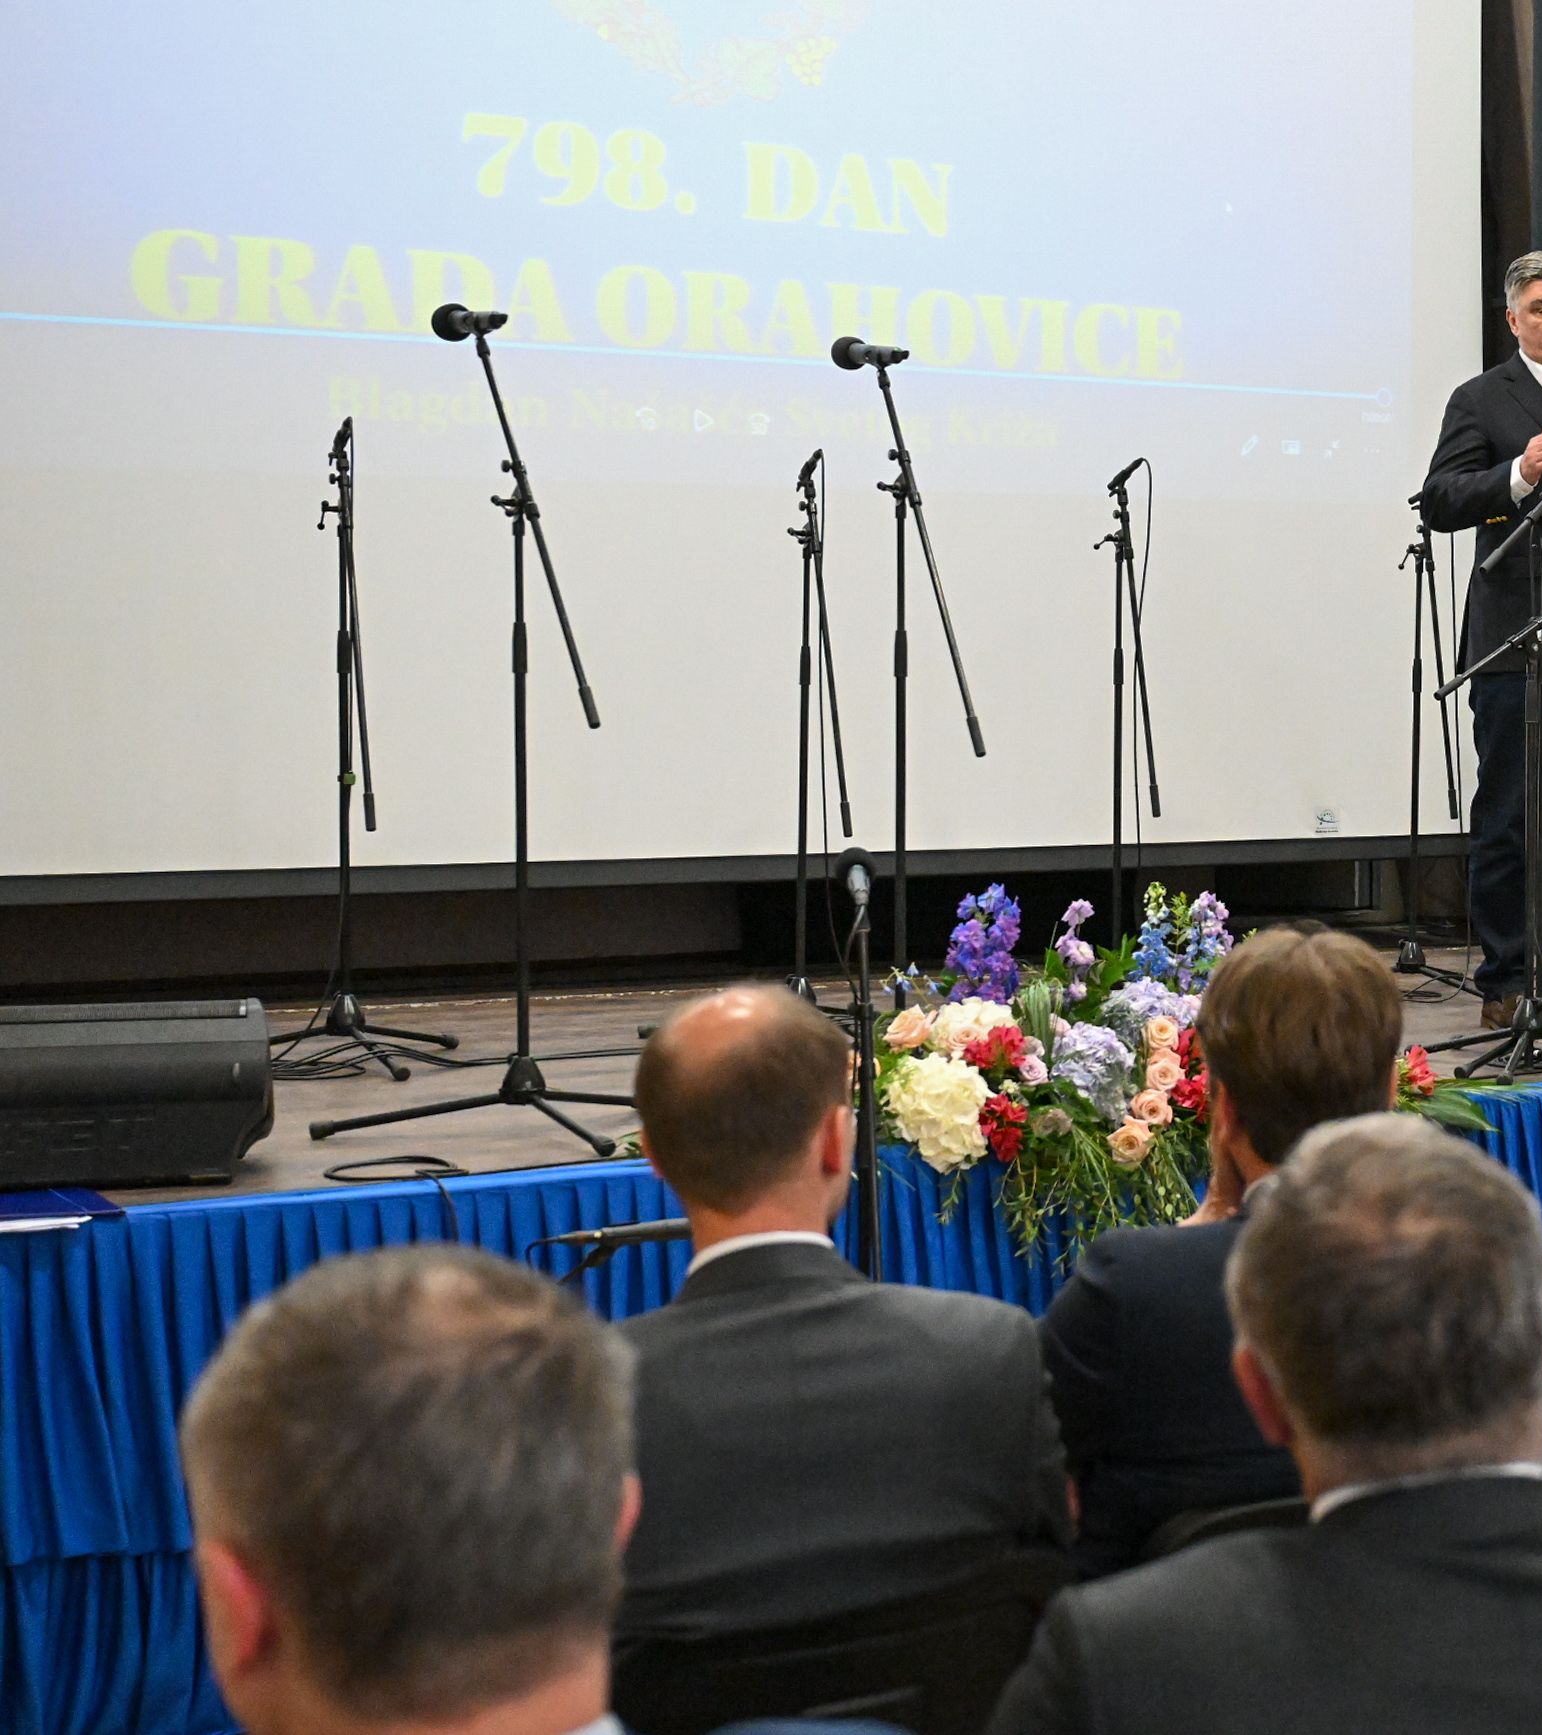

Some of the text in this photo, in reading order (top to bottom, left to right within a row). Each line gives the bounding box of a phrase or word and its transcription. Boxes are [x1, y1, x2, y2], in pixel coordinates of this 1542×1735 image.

[461, 113, 953, 238] 798. DAN
[130, 228, 1184, 380] GRADA ORAHOVICE
